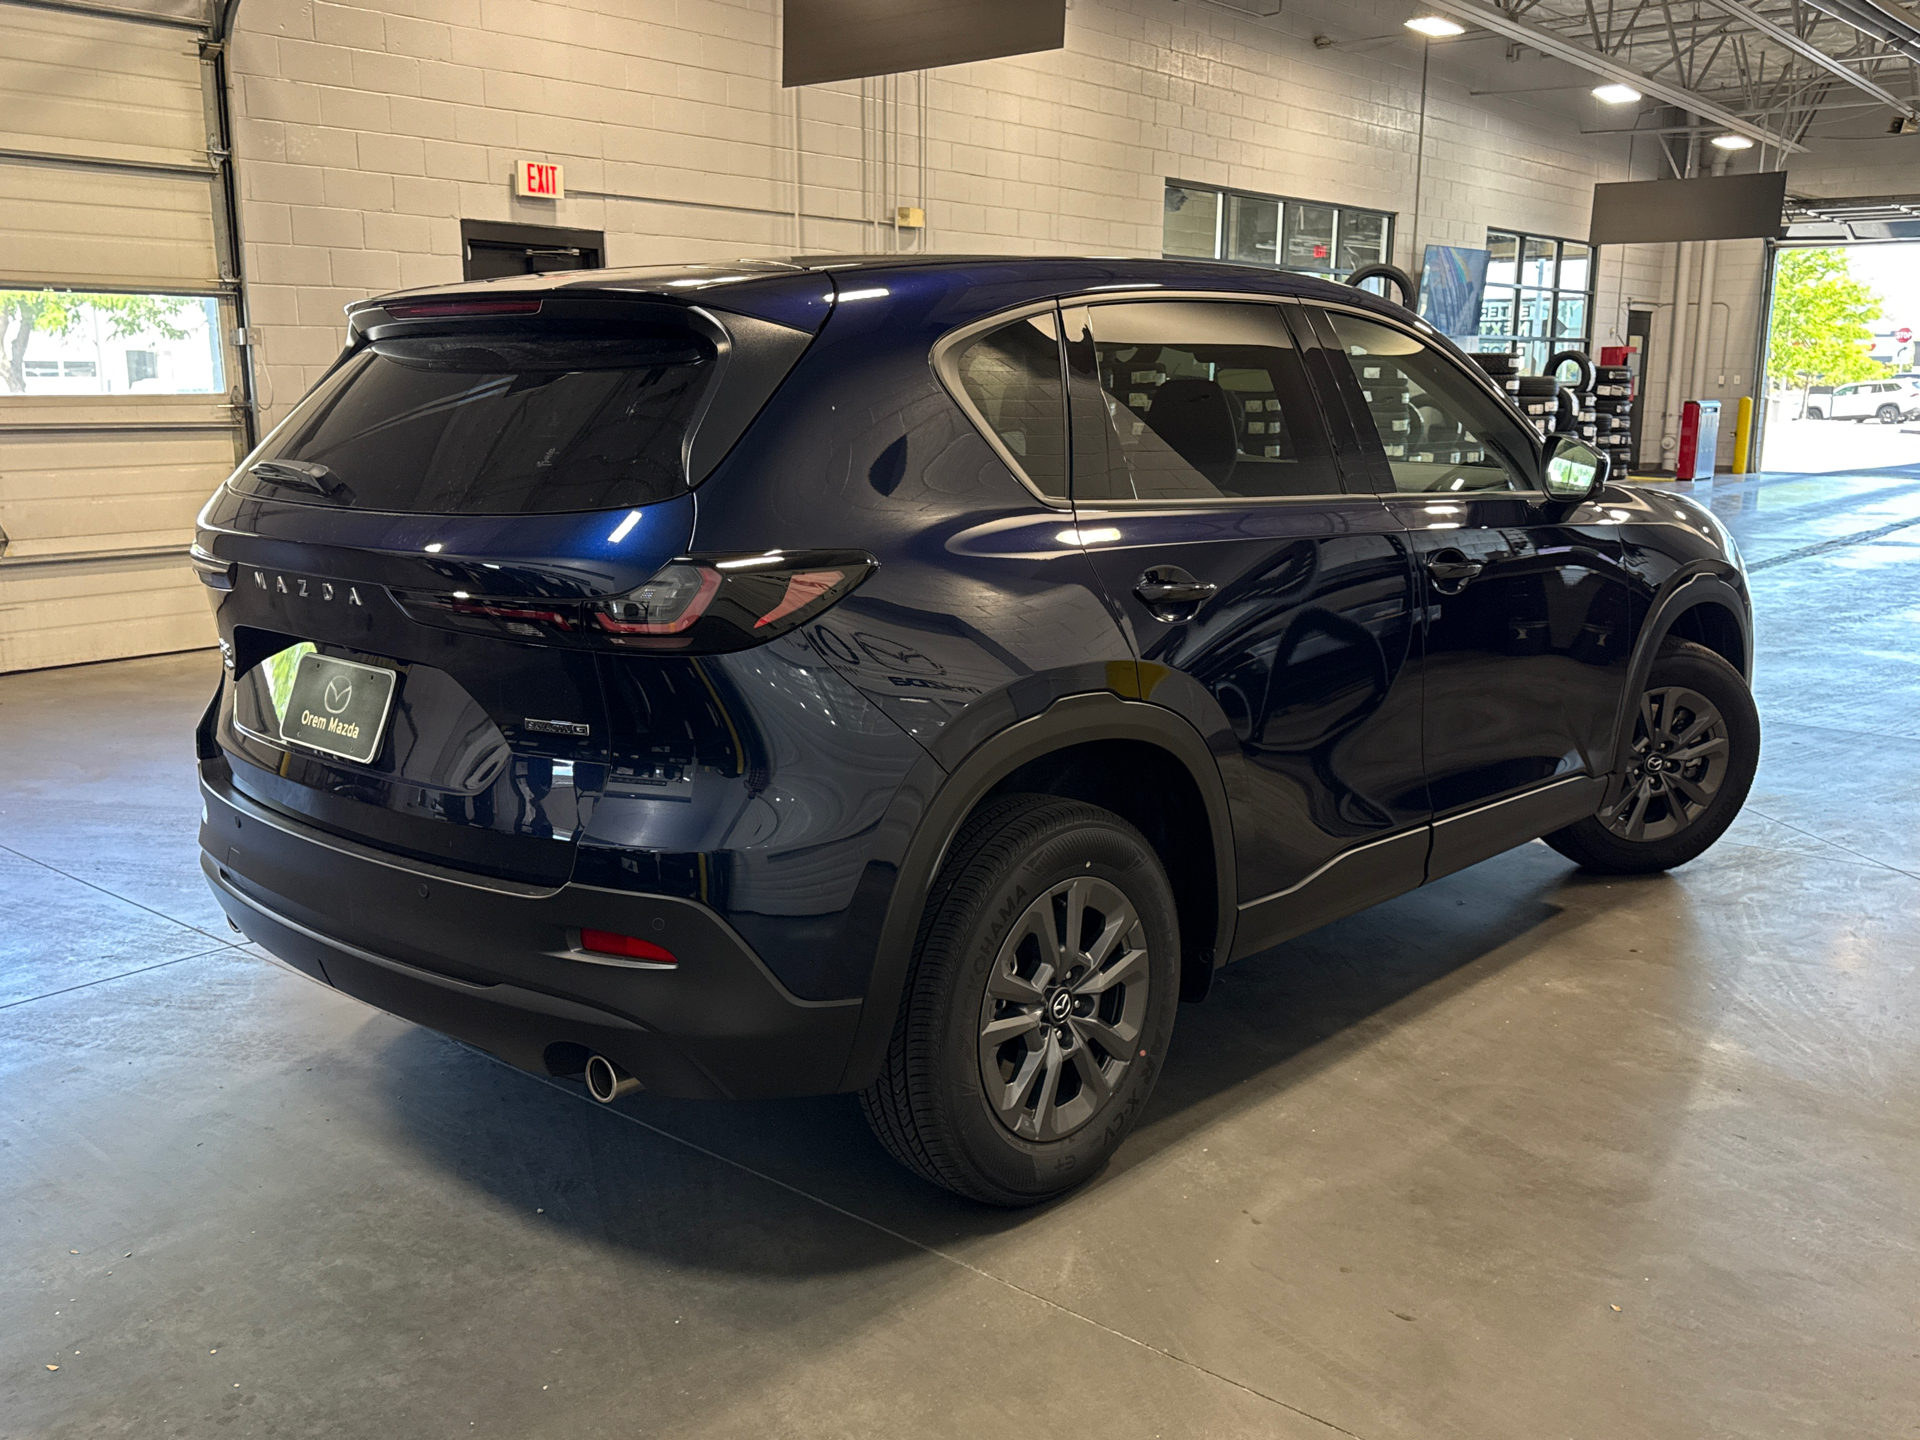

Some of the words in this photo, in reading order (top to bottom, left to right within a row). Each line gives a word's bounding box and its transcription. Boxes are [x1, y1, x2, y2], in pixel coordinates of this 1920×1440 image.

[527, 163, 557, 194] EXIT
[1895, 331, 1912, 339] STOP
[254, 571, 362, 606] MAZDA
[301, 709, 327, 731] Orem
[327, 717, 360, 739] Mazda
